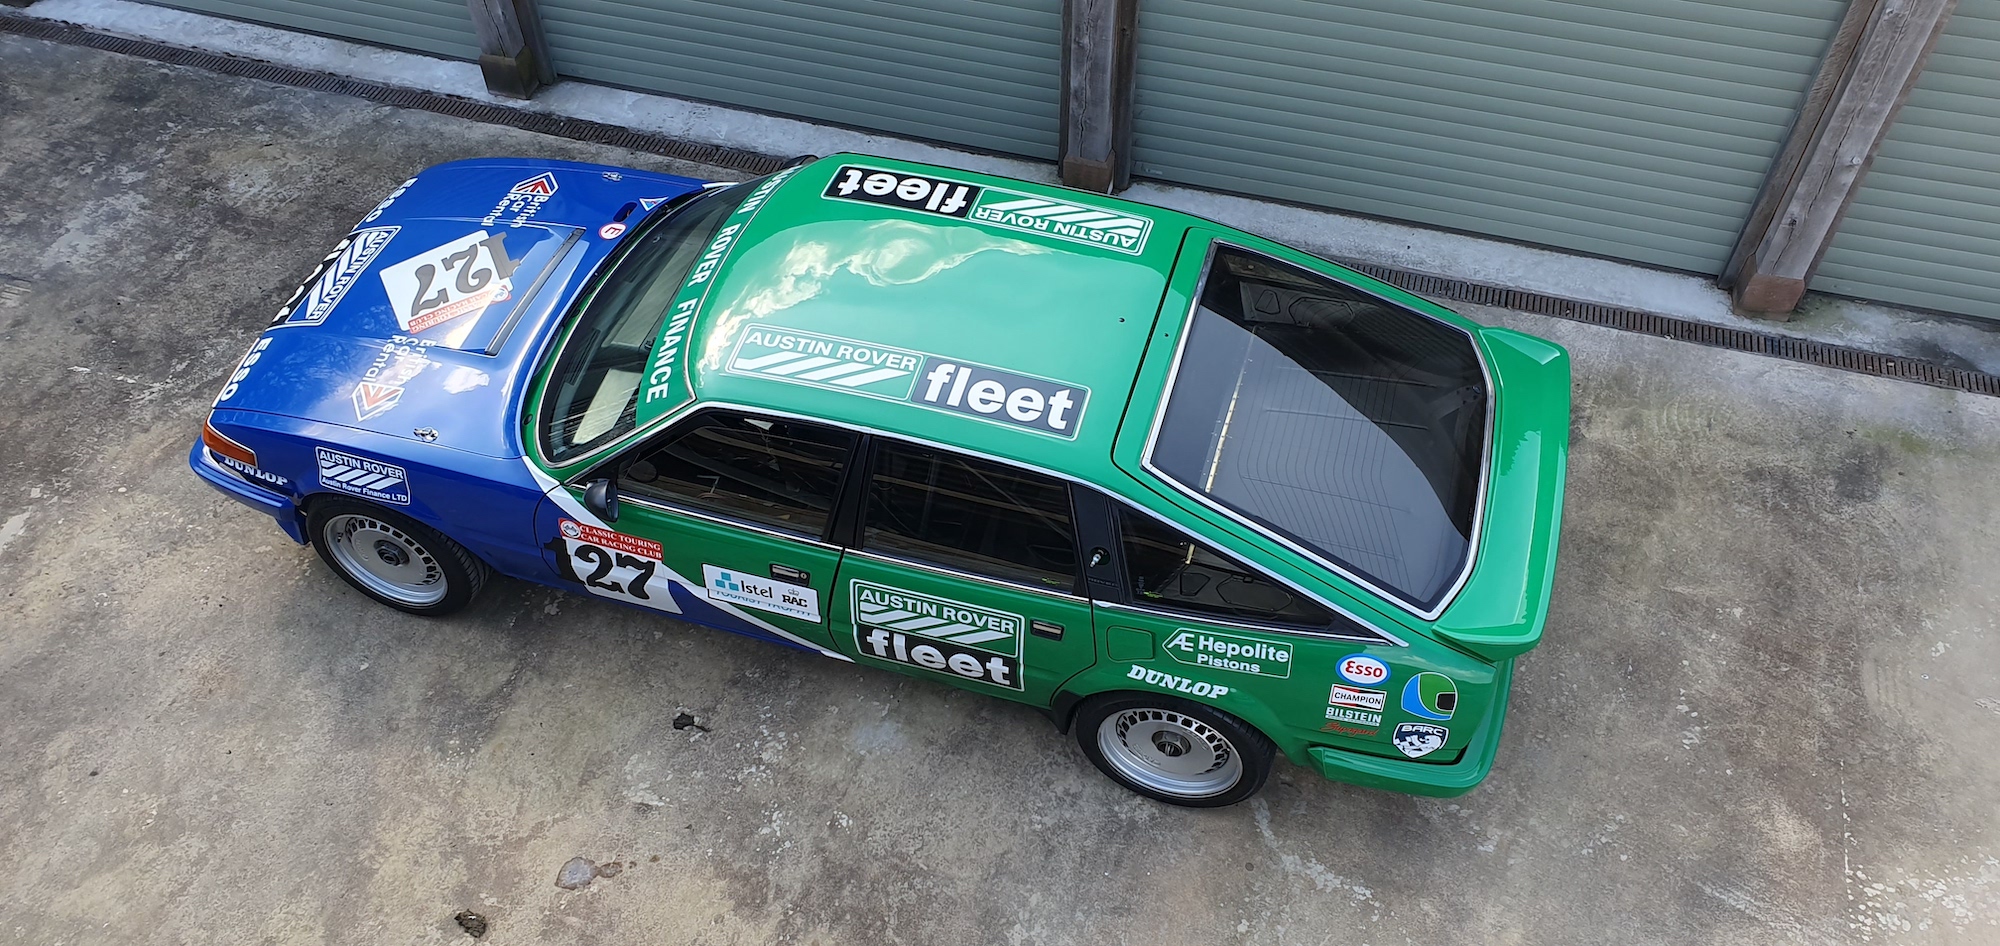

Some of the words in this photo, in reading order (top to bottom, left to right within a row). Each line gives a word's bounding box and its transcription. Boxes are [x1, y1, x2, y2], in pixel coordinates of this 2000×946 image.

[510, 194, 532, 212] Car
[837, 168, 969, 215] fleet
[481, 193, 518, 227] Rental
[510, 195, 549, 228] British
[976, 206, 1046, 231] ROVER
[1052, 221, 1138, 248] AUSTIN
[345, 231, 389, 274] AUSTIN
[687, 223, 741, 287] ROVER
[411, 232, 521, 317] 127
[308, 276, 349, 320] ROVER
[409, 313, 433, 327] CLUB
[363, 335, 408, 382] Rental
[646, 297, 698, 403] FINANCE
[745, 331, 836, 356] AUSTIN
[836, 345, 917, 371] ROVER
[924, 363, 1074, 430] fleet
[224, 457, 288, 485] DUNLOP
[320, 450, 362, 470] AUSTIN
[364, 461, 404, 480] ROVER
[322, 477, 341, 489] Austin
[342, 481, 361, 493] Rover
[363, 488, 390, 500] Finance
[392, 492, 408, 502] LTD
[580, 525, 617, 540] CLASSIC
[620, 535, 661, 551] TOURING
[581, 533, 600, 543] CAR
[601, 538, 636, 553] RACING
[637, 546, 662, 559] CLUB
[544, 536, 655, 600] 127
[741, 580, 773, 599] Istel
[782, 594, 808, 608] RAC
[860, 589, 937, 617] AUSTIN
[942, 607, 1015, 634] ROVER
[866, 628, 1010, 685] fleet
[1197, 653, 1261, 673] Pistons
[1198, 635, 1289, 662] Hepolite
[1127, 664, 1229, 699] DUNLOP
[1334, 691, 1381, 705] CHAMPION
[1326, 707, 1382, 723] BILSTEIN
[1401, 725, 1444, 736] BARC
